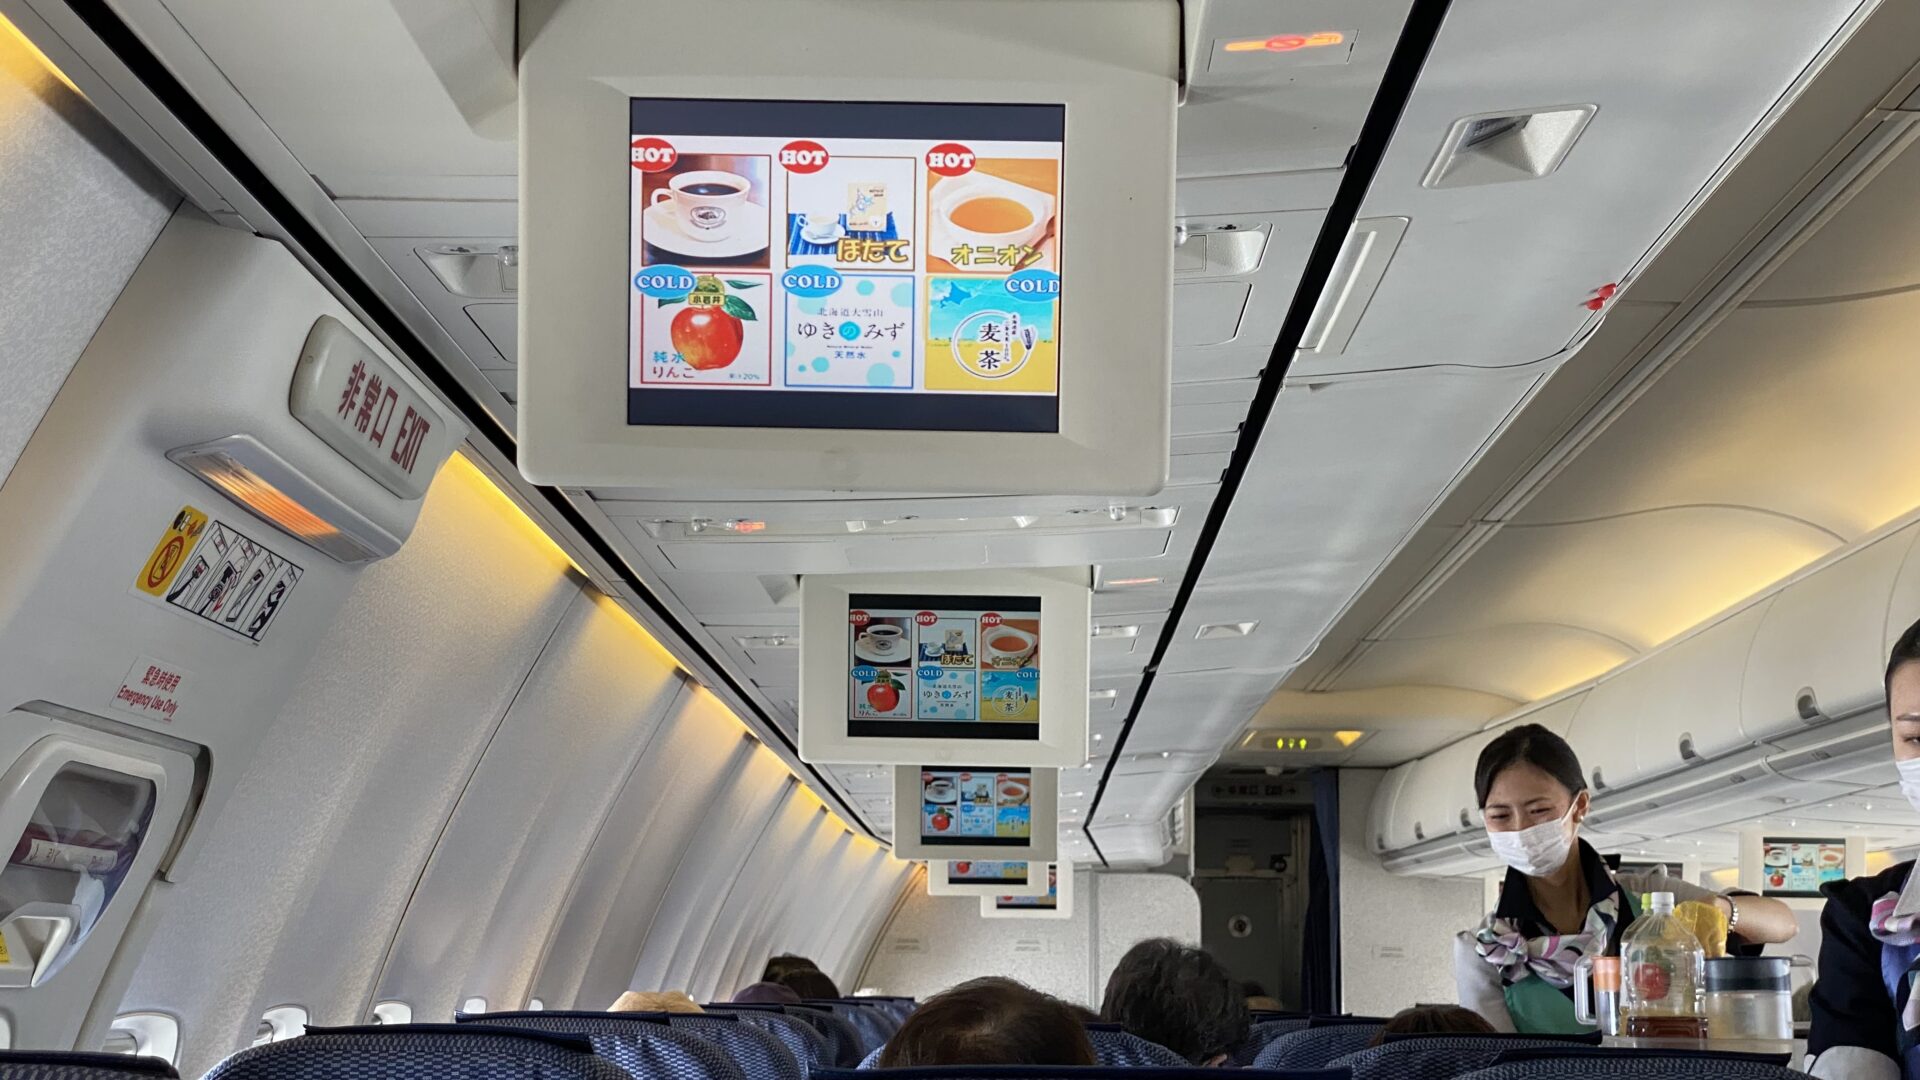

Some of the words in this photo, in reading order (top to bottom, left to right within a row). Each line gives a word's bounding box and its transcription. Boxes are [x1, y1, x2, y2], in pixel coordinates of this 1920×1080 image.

[631, 147, 675, 163] HOT
[781, 150, 827, 166] HOT
[929, 153, 974, 168] HOT
[837, 238, 909, 262] ほたて
[951, 244, 1043, 266] オニオン
[636, 275, 693, 290] COLD
[783, 275, 840, 289] COLD
[1005, 280, 1060, 293] COLD
[798, 322, 905, 341] ゆきのみず
[978, 323, 1001, 370] 麦茶
[337, 360, 399, 449] 非常口
[390, 405, 431, 475] EXIT
[916, 615, 937, 623] HOT
[982, 616, 1001, 624] HOT
[941, 654, 975, 666] ほたて
[117, 684, 153, 710] Emergency
[150, 695, 165, 711] Use
[162, 699, 179, 718] Only
